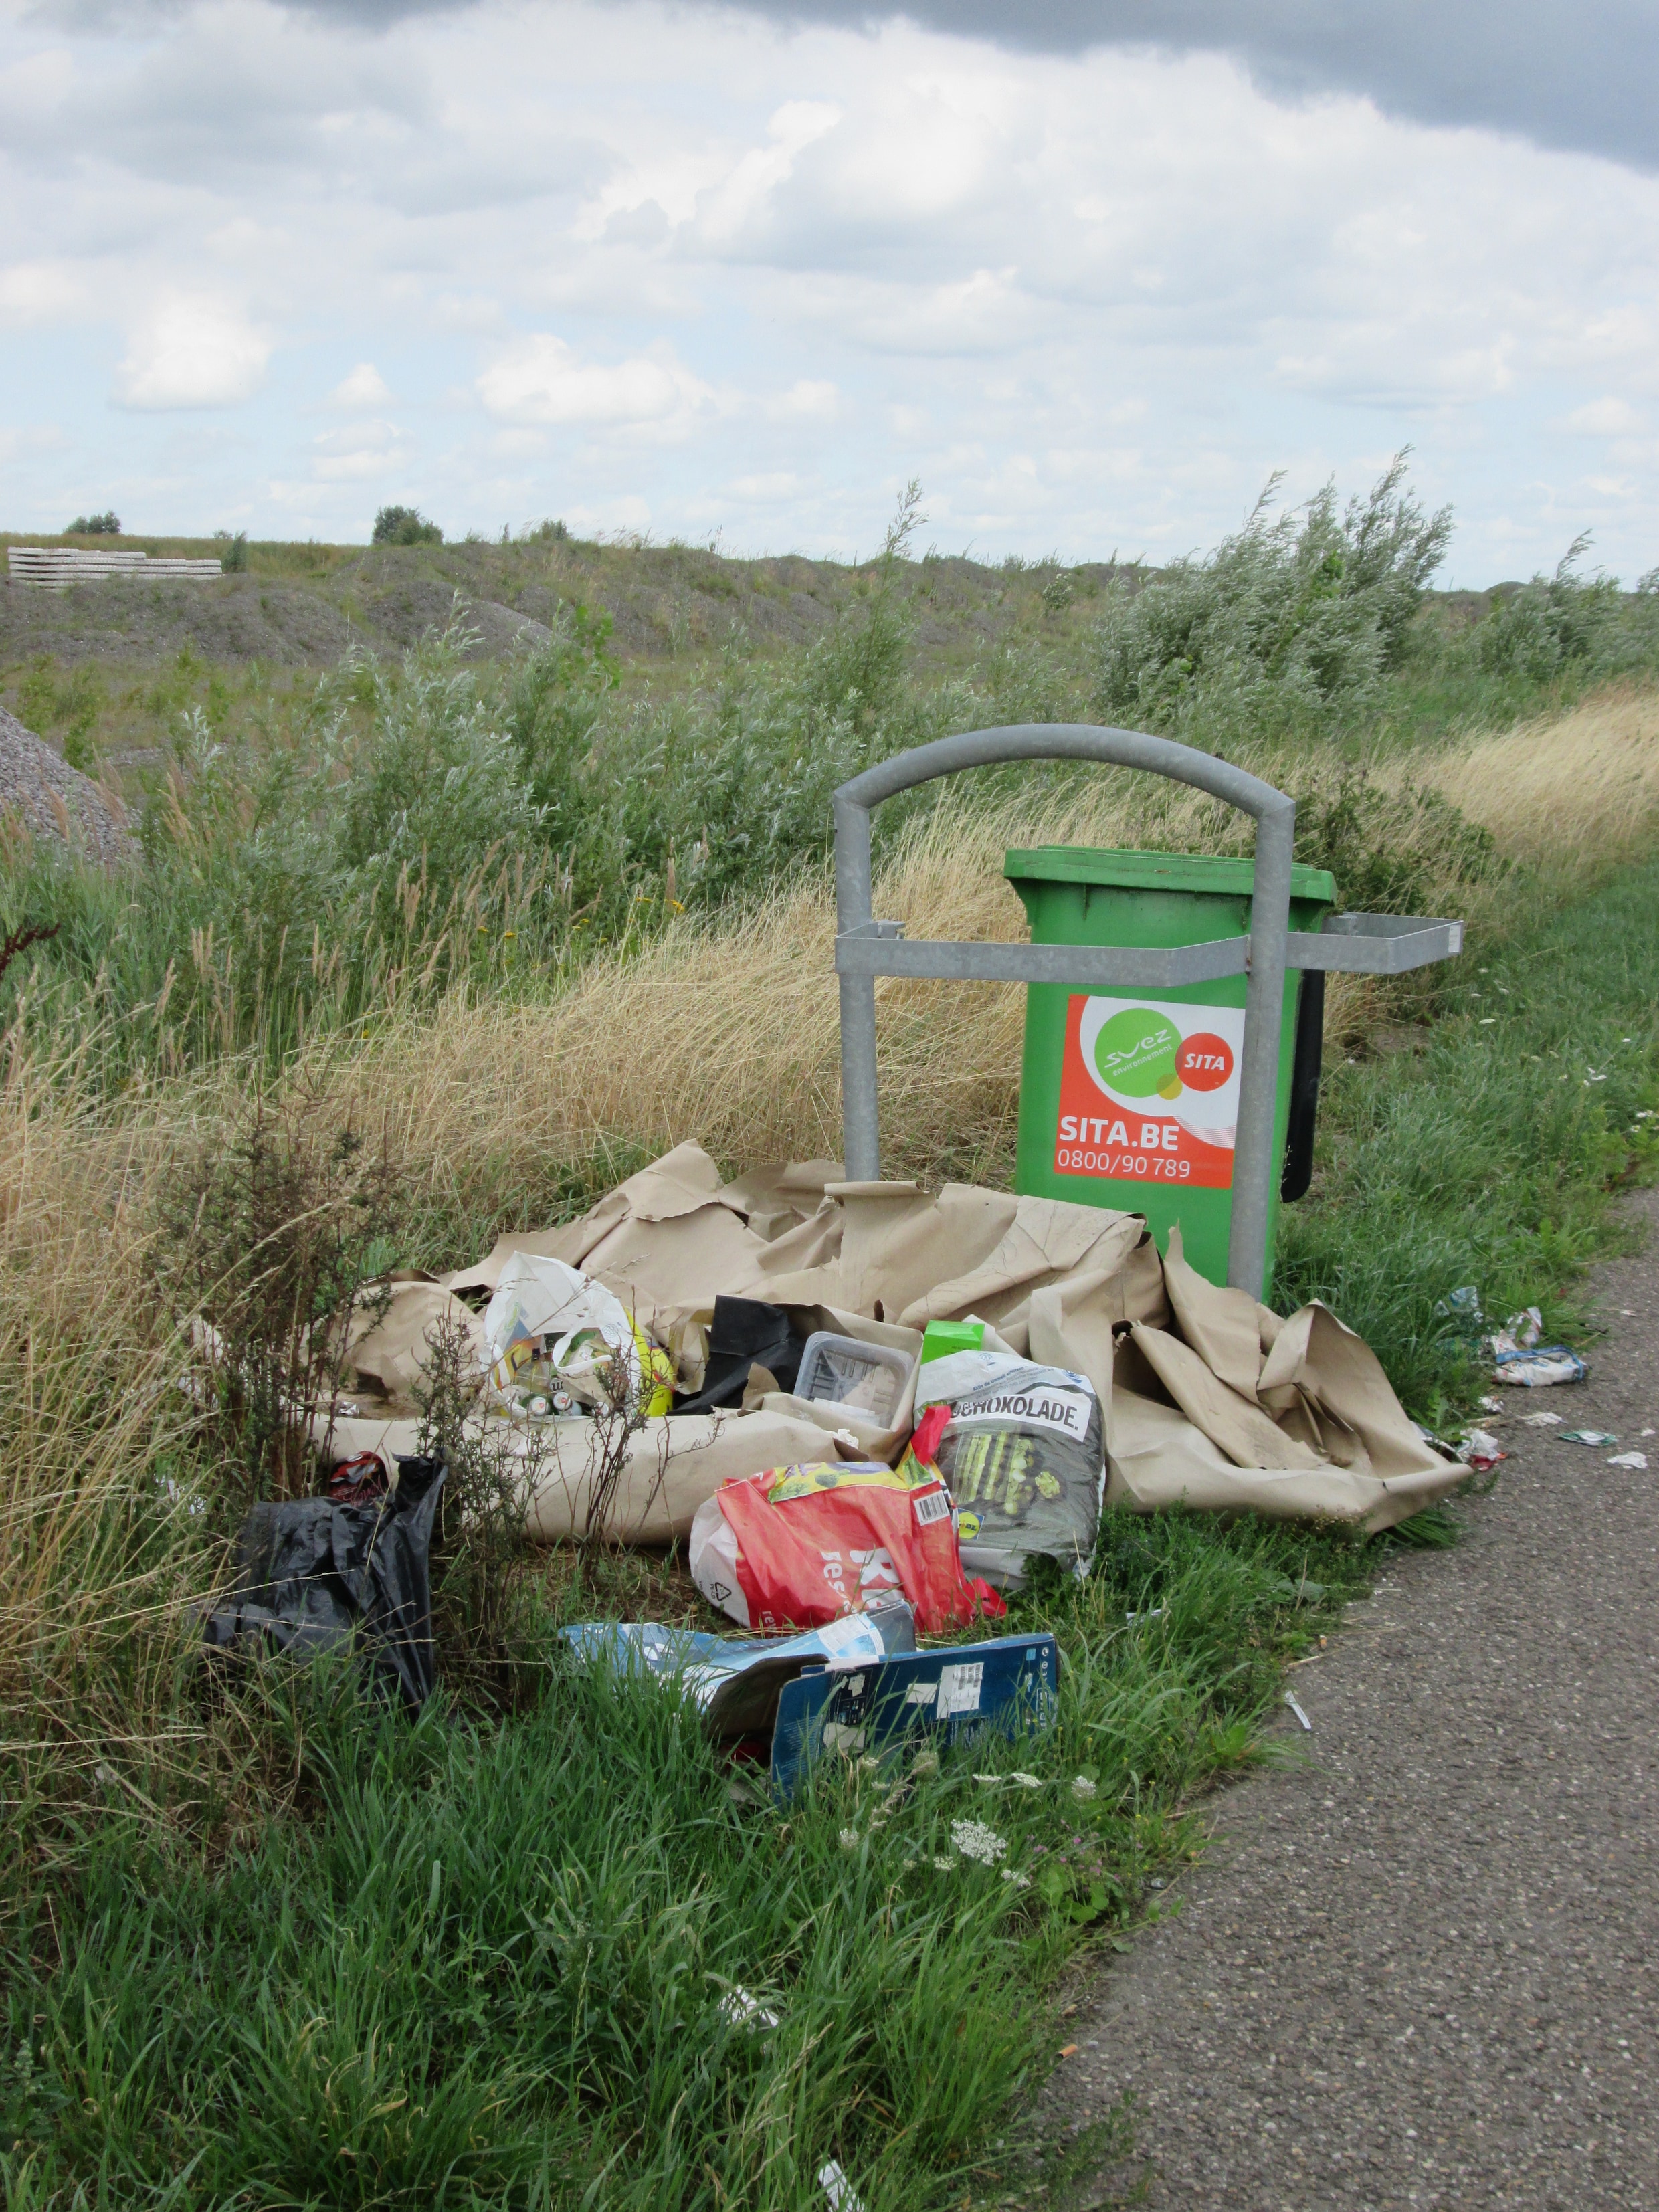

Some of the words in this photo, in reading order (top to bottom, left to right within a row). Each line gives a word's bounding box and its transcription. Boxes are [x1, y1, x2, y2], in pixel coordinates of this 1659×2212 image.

[1104, 1029, 1171, 1069] suez
[1112, 1044, 1173, 1076] environnement
[1184, 1053, 1225, 1070] SITA
[1059, 1116, 1179, 1150] SITA.BE
[1058, 1148, 1148, 1174] 0800/90
[1153, 1158, 1191, 1178] 789
